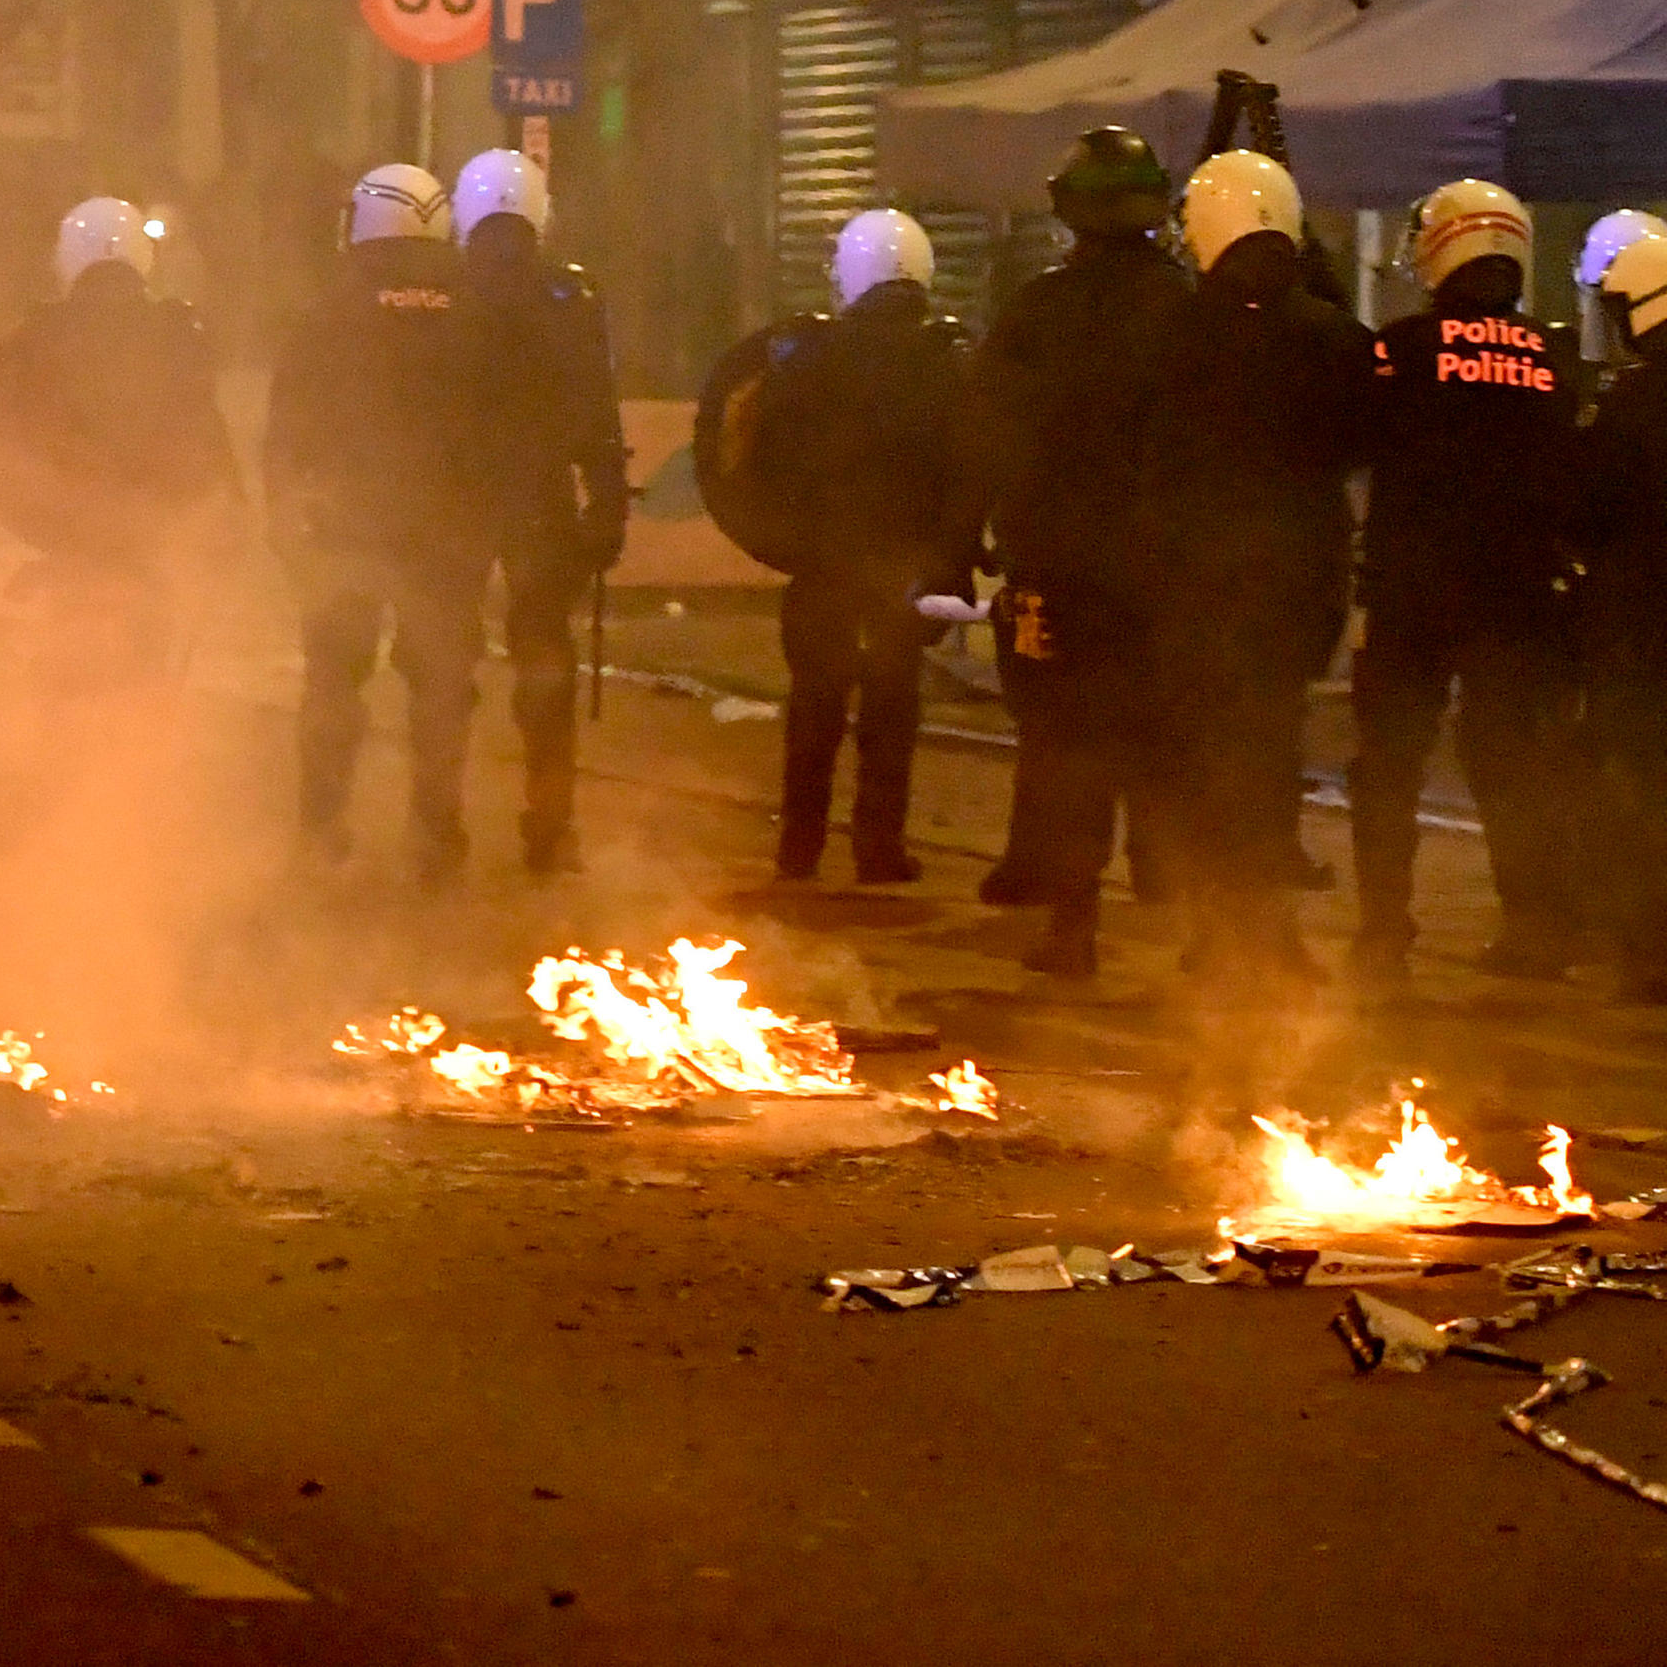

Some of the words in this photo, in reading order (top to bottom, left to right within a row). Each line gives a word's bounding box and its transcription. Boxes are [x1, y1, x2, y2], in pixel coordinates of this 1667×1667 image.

[507, 78, 573, 107] TAXI
[1440, 316, 1546, 352] Police
[1437, 351, 1555, 392] Politie
